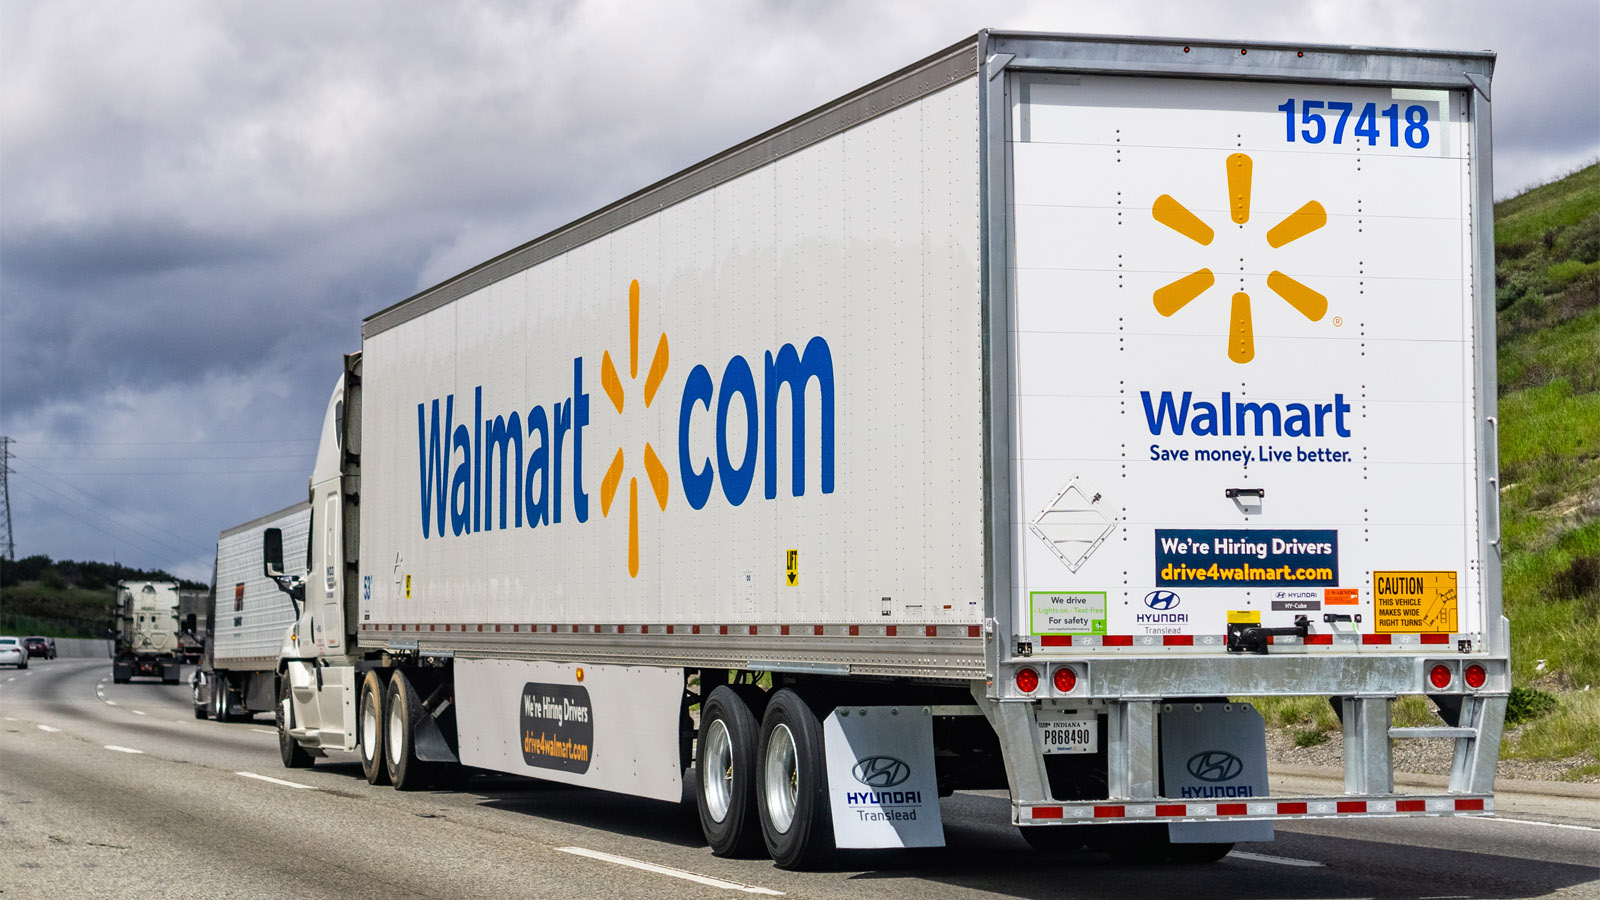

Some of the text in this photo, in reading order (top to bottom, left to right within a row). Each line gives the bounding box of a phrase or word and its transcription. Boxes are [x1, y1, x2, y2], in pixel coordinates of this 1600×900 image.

[1278, 98, 1430, 149] 157418
[1139, 391, 1351, 437] Walmart
[417, 336, 835, 539] Walmart com
[1150, 444, 1352, 466] Save money. Live better.
[1161, 537, 1332, 559] We're Hiring Drivers
[786, 550, 798, 570] LIFT
[1161, 563, 1333, 581] drive4walmart.com
[1378, 577, 1424, 595] CAUTION
[1050, 596, 1087, 604] We drive
[1379, 598, 1422, 606] THIS VEHICLE
[1038, 607, 1059, 615] Lights
[1136, 613, 1189, 623] HYUNDAI
[1048, 616, 1089, 626] For safety
[1379, 619, 1423, 627] RIGHT TURNS
[1144, 626, 1182, 635] Translead
[524, 694, 589, 727] We're Hiring Drivers
[1044, 729, 1090, 745] P868490
[524, 730, 589, 762] drive4walmart.com
[847, 791, 922, 804] HYUNDAI
[1181, 785, 1253, 798] HYUNDAI
[857, 809, 917, 821] Translead
